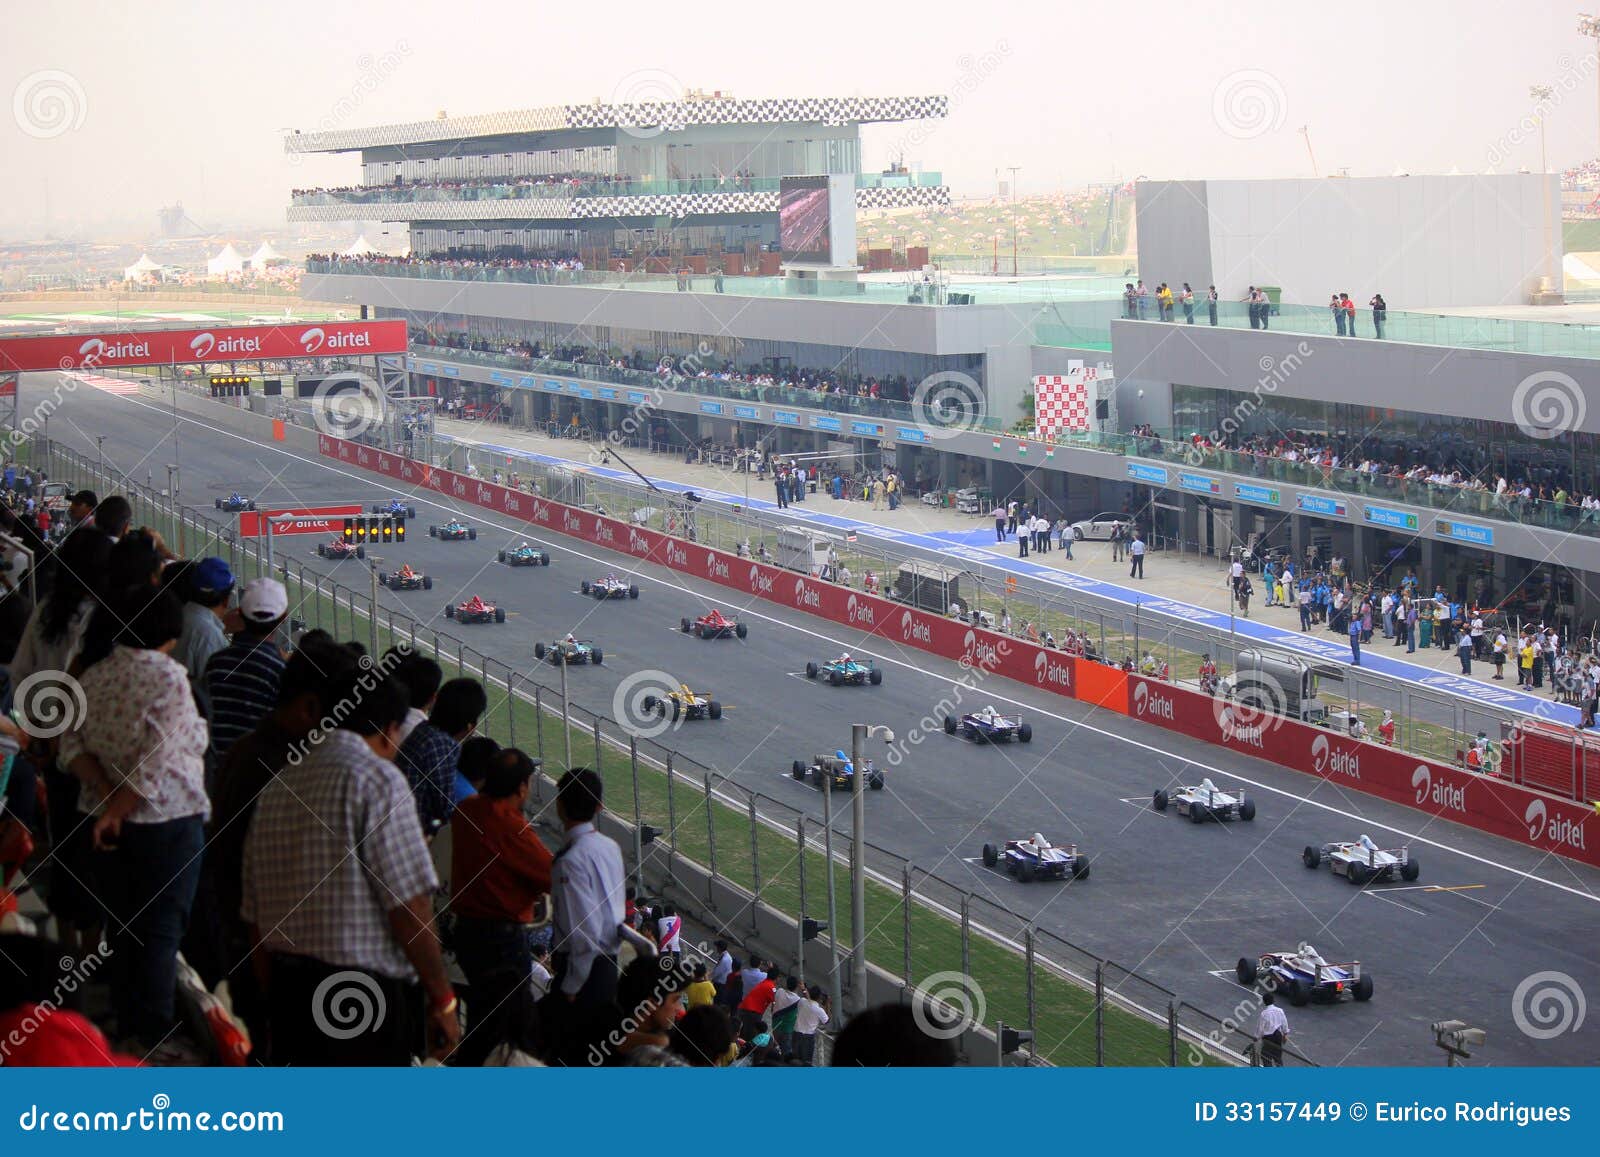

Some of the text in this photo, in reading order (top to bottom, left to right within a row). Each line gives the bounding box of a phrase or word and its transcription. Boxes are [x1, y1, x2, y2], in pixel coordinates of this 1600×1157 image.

[107, 341, 150, 358] airtel
[218, 336, 260, 352] airtel
[328, 331, 370, 347] airtel
[758, 572, 773, 592] airtel
[804, 585, 820, 608] airtel
[857, 602, 874, 625] airtel
[913, 618, 931, 643] airtel
[976, 640, 996, 664] airtel
[1048, 664, 1070, 688] airtel
[1149, 691, 1174, 720] airtel
[1235, 718, 1264, 749] airtel
[1330, 748, 1361, 779] airtel
[1432, 779, 1466, 813] airtel
[1548, 813, 1585, 850] airtel
